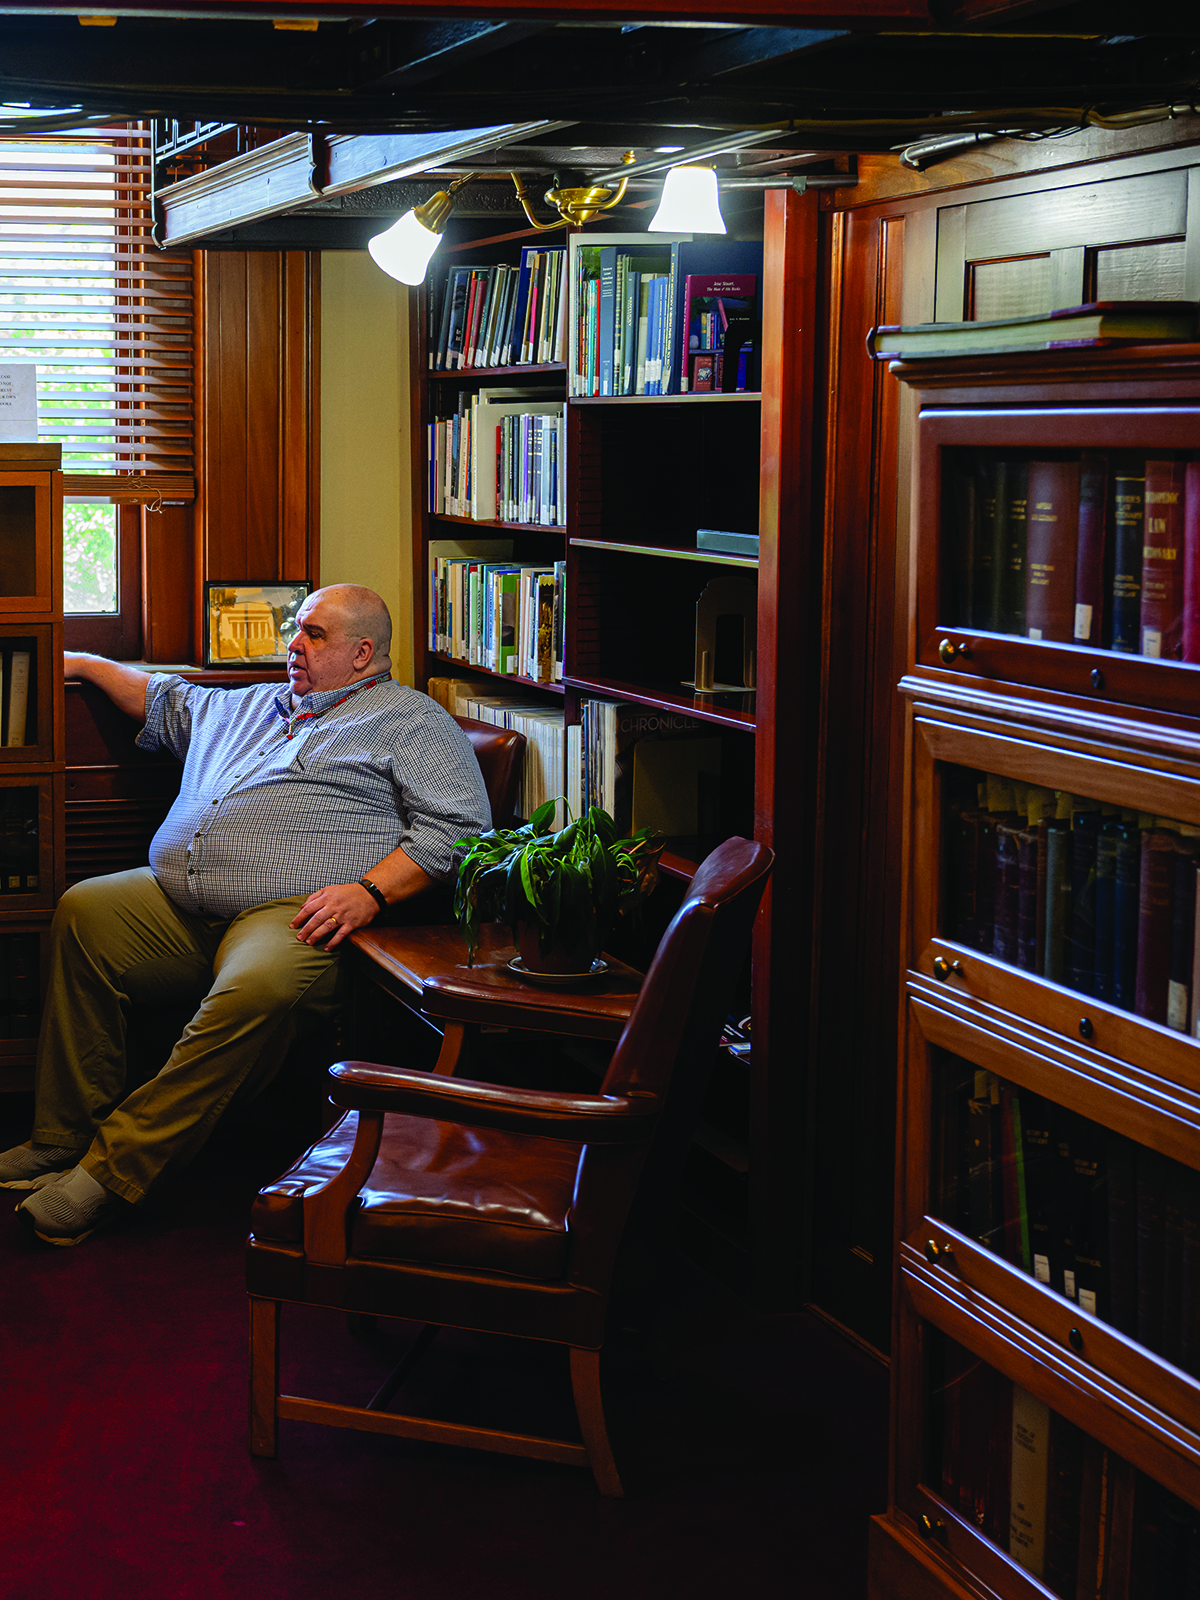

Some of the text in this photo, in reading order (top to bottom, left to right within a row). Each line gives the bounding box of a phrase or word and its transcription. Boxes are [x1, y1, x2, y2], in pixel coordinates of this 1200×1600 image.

[1148, 517, 1166, 533] LAW
[620, 716, 700, 732] CHRONICLE
[1075, 1166, 1096, 1176] KENTUCKY
